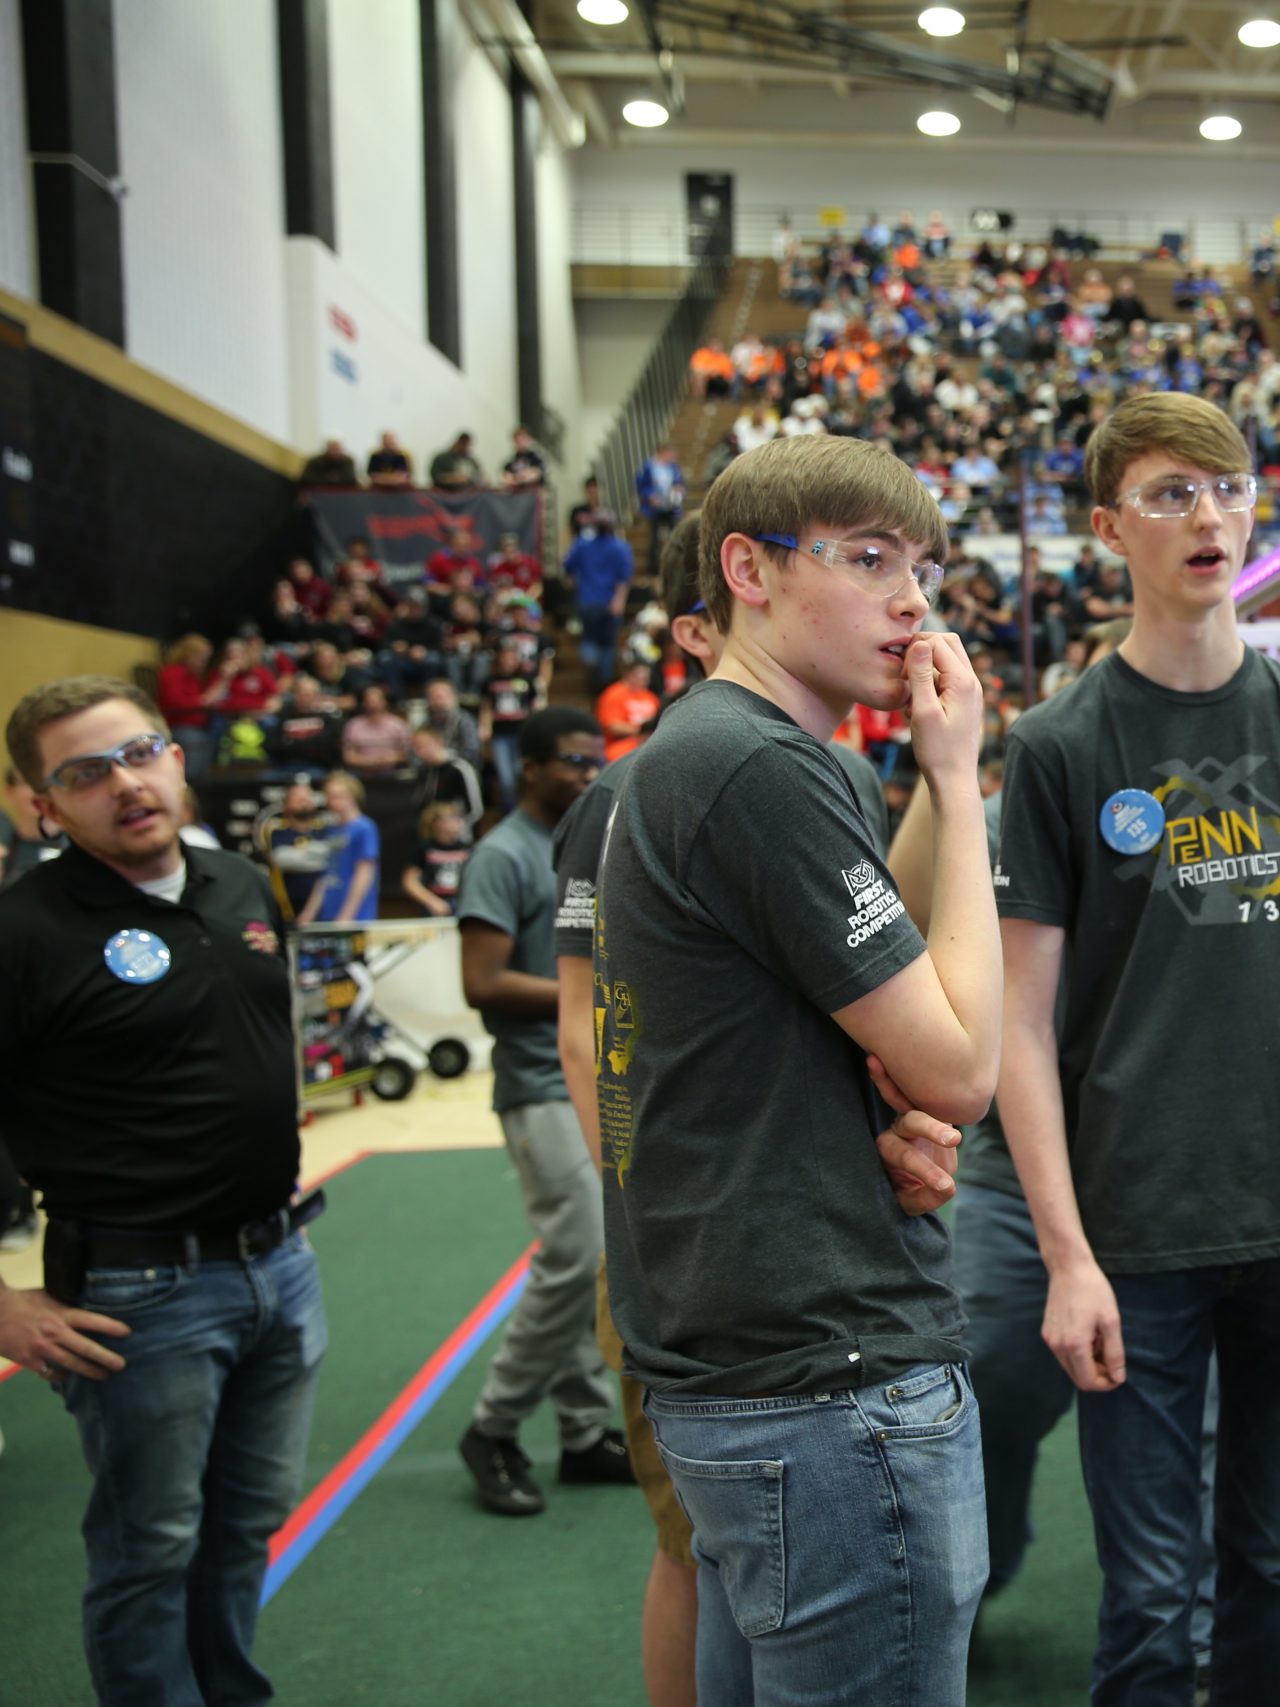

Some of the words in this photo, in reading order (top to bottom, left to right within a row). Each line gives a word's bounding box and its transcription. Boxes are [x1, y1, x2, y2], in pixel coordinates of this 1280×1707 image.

[1165, 806, 1262, 866] PENN
[847, 889, 897, 930] ROBOTICS
[853, 879, 886, 911] FIRST
